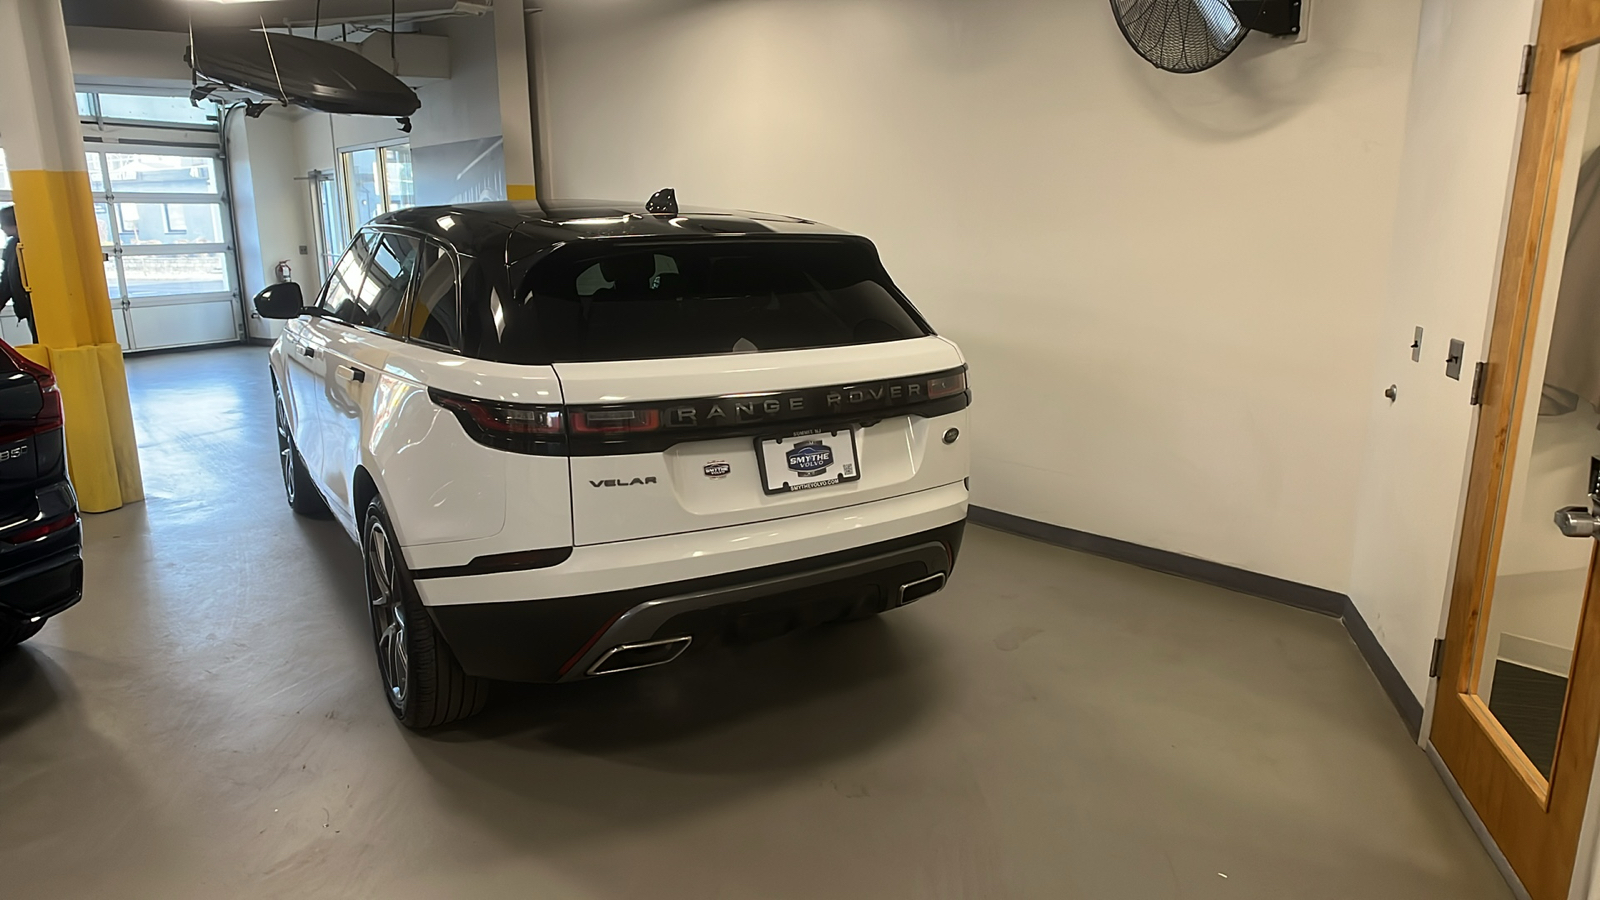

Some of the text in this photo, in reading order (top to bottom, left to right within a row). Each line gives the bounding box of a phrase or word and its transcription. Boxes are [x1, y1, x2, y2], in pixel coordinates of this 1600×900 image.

[677, 384, 921, 421] RANGE ROVER
[790, 453, 829, 465] SMYTHE
[800, 460, 824, 468] VOLVO
[589, 476, 657, 488] VELAR
[790, 478, 839, 491] SMYTHEVOLVO.COM
